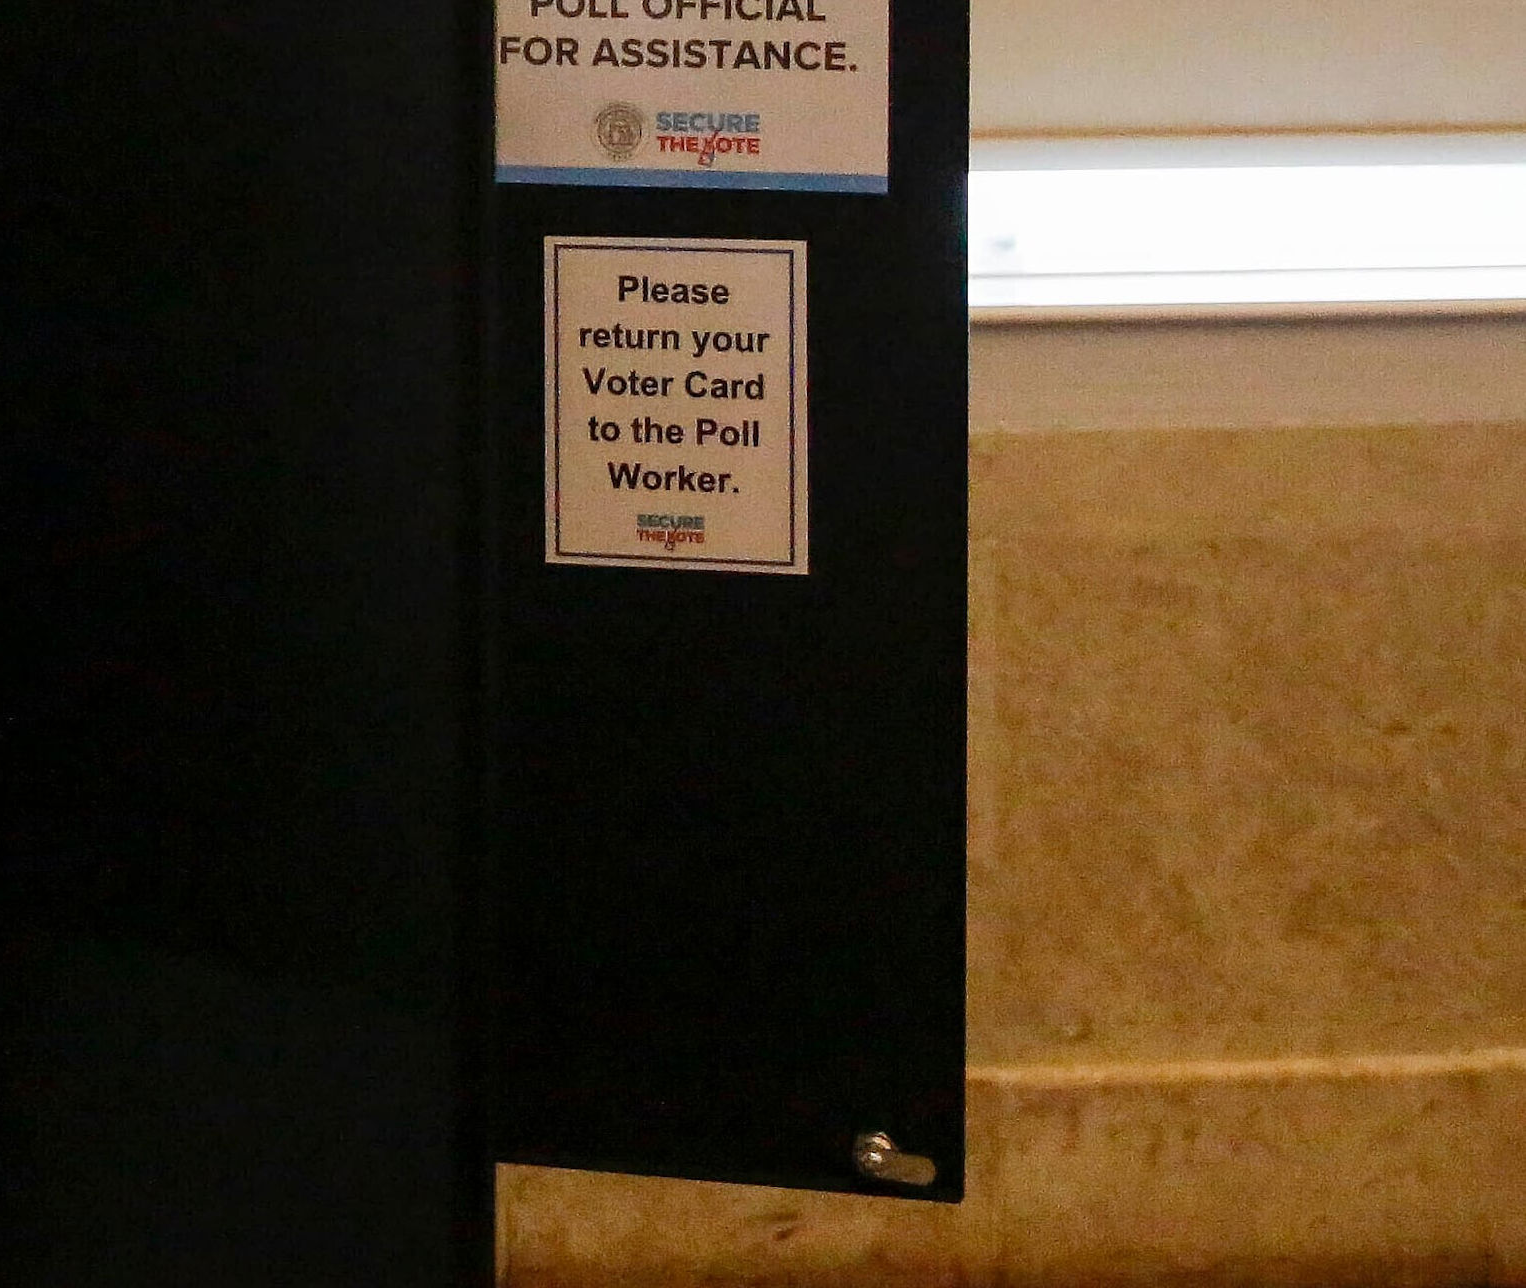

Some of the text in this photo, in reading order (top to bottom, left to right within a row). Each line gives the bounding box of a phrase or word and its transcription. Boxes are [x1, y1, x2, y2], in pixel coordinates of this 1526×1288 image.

[500, 36, 858, 72] FOR ASSISTANCE.
[656, 112, 761, 134] SECURE
[657, 136, 699, 154] THE
[618, 275, 730, 305] Please
[579, 323, 770, 357] return your
[582, 367, 764, 400] Voter Card
[588, 417, 759, 446] to the Poll
[608, 462, 739, 493] Worker.
[637, 514, 704, 530] SECURE
[637, 529, 668, 541] THE
